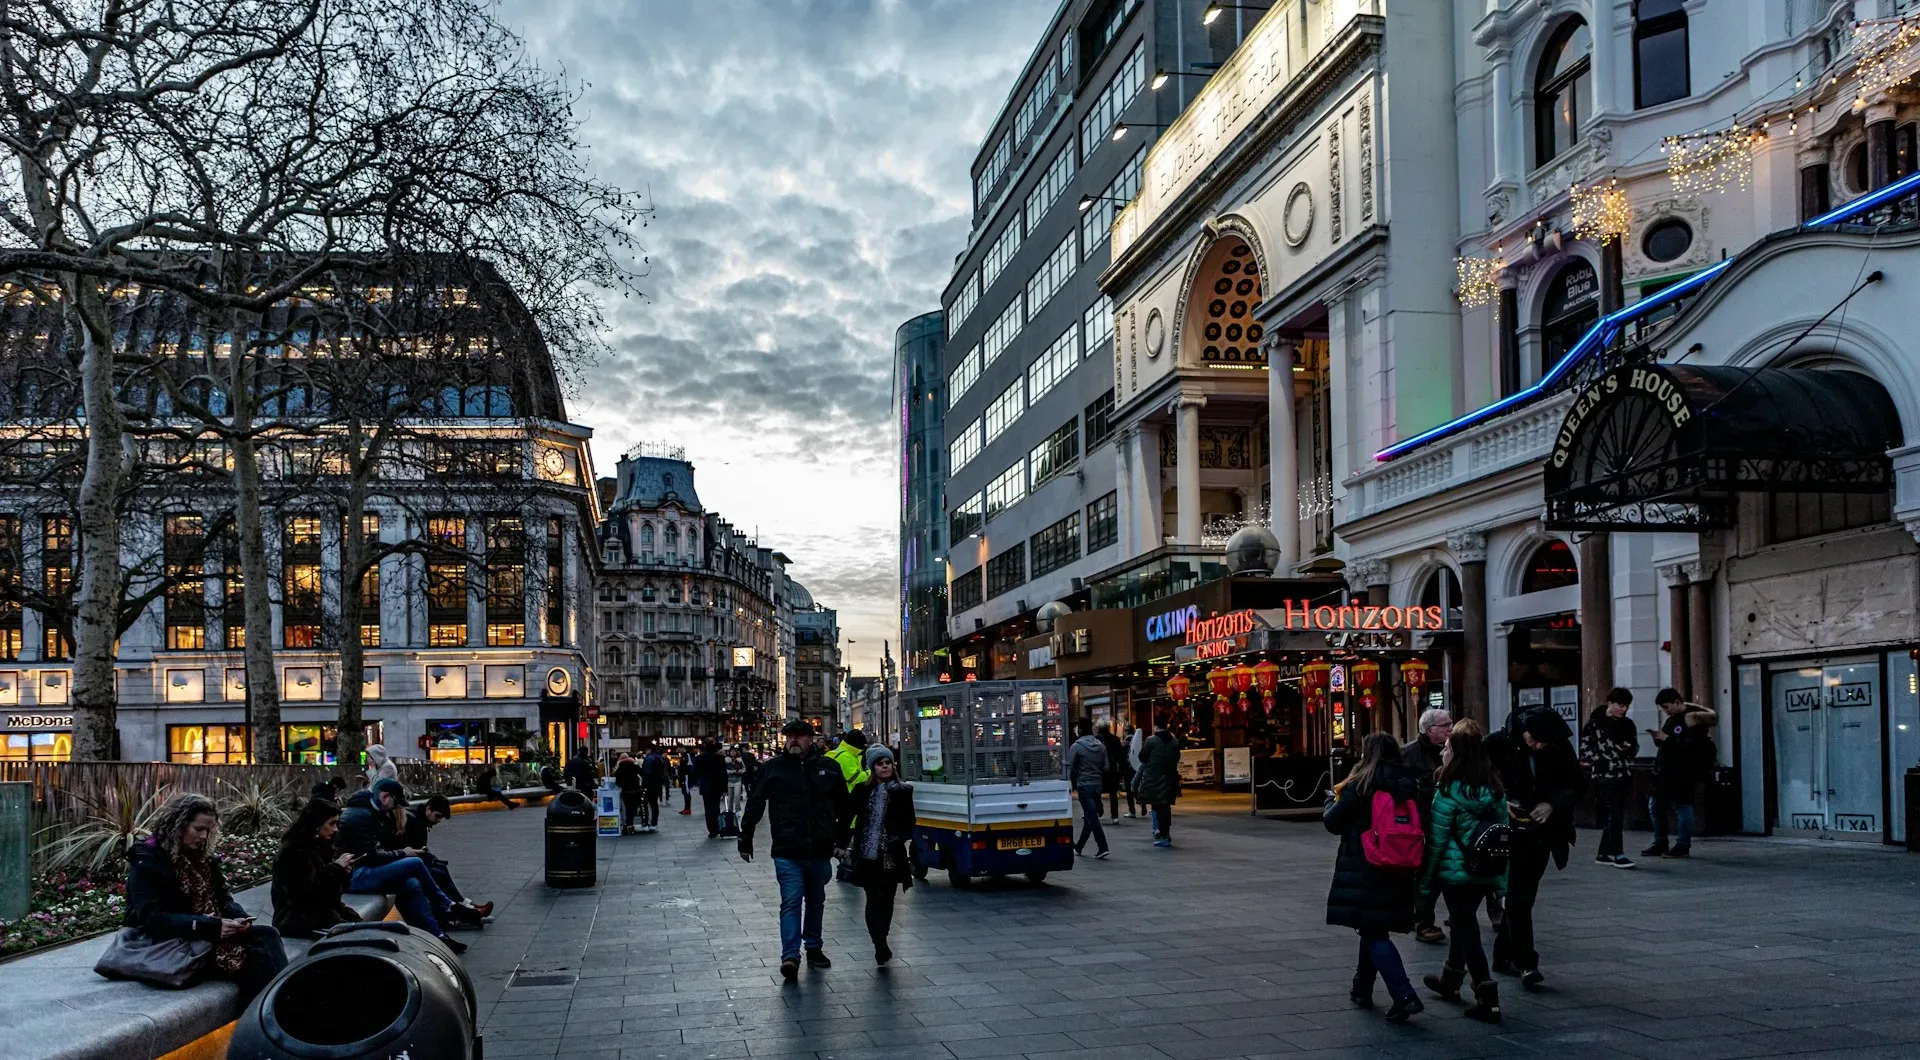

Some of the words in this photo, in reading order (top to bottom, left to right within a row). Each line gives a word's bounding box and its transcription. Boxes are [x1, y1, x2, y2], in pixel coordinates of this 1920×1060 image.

[1160, 132, 1206, 199] EMPIRE
[1212, 49, 1282, 141] THEATRE
[1565, 267, 1594, 287] Ruby
[1567, 281, 1591, 299] Blue
[1553, 374, 1618, 468] QUEEN'S
[1630, 368, 1691, 428] HOUSE
[1145, 604, 1198, 642] CASINO
[1283, 598, 1443, 630] Horizons
[1185, 608, 1253, 646] Horizons
[1196, 639, 1230, 660] CASINO
[1325, 631, 1404, 648] CASINO
[1790, 692, 1815, 708] LXA
[1837, 687, 1866, 703] LXA
